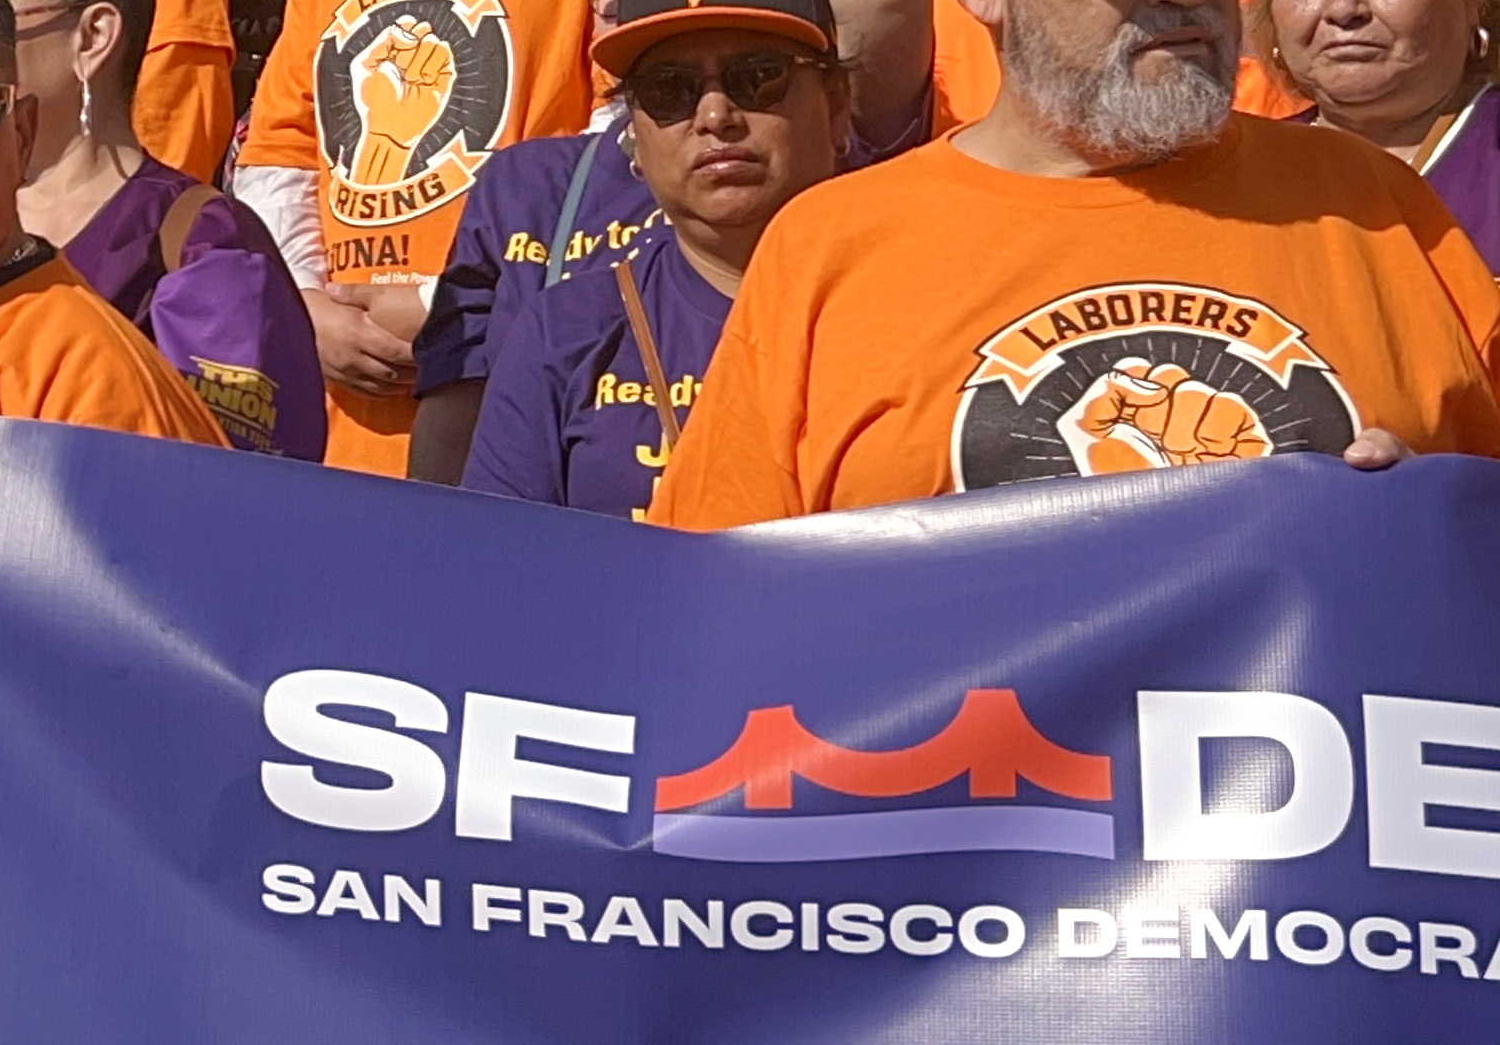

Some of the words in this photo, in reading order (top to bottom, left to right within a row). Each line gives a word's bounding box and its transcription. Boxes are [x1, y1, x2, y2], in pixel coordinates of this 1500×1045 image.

[335, 172, 447, 219] RISING
[1019, 291, 1259, 351] LABORERS
[261, 668, 636, 842] SF
[261, 863, 442, 927] SAN
[472, 883, 1027, 957] FRANCISCO
[1057, 907, 1500, 980] DEMOCR
